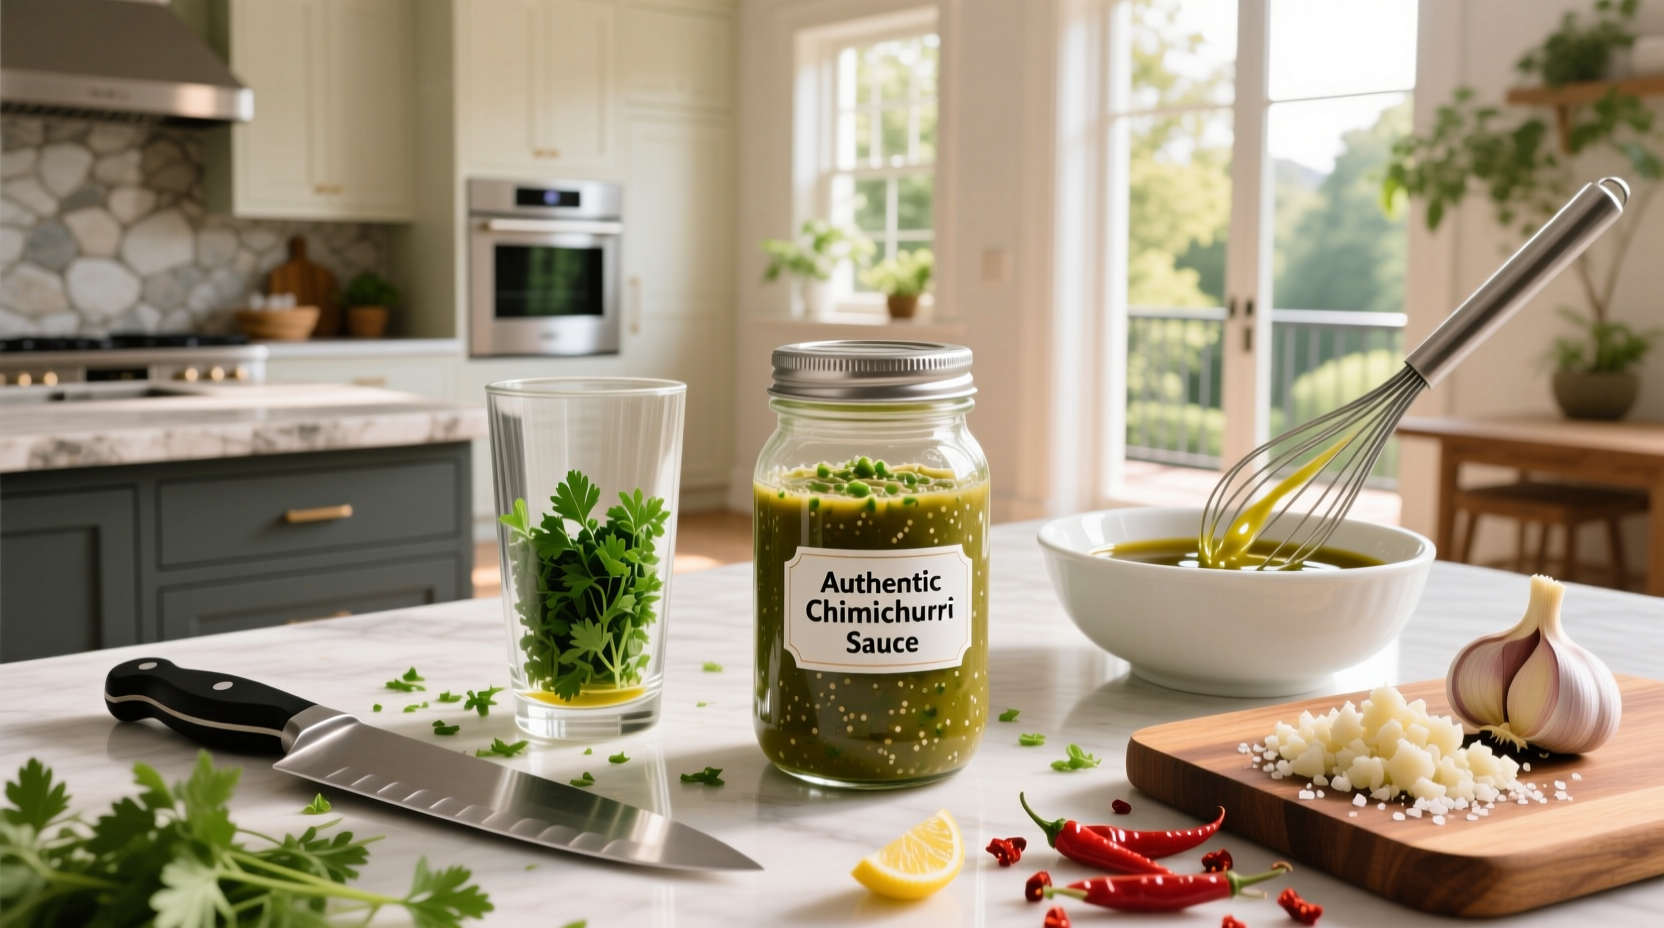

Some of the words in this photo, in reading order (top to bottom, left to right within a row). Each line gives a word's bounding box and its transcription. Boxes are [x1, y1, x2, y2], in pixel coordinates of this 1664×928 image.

[820, 569, 942, 594] Authentic
[805, 596, 954, 624] Chimichurri
[846, 630, 919, 654] Sauce
